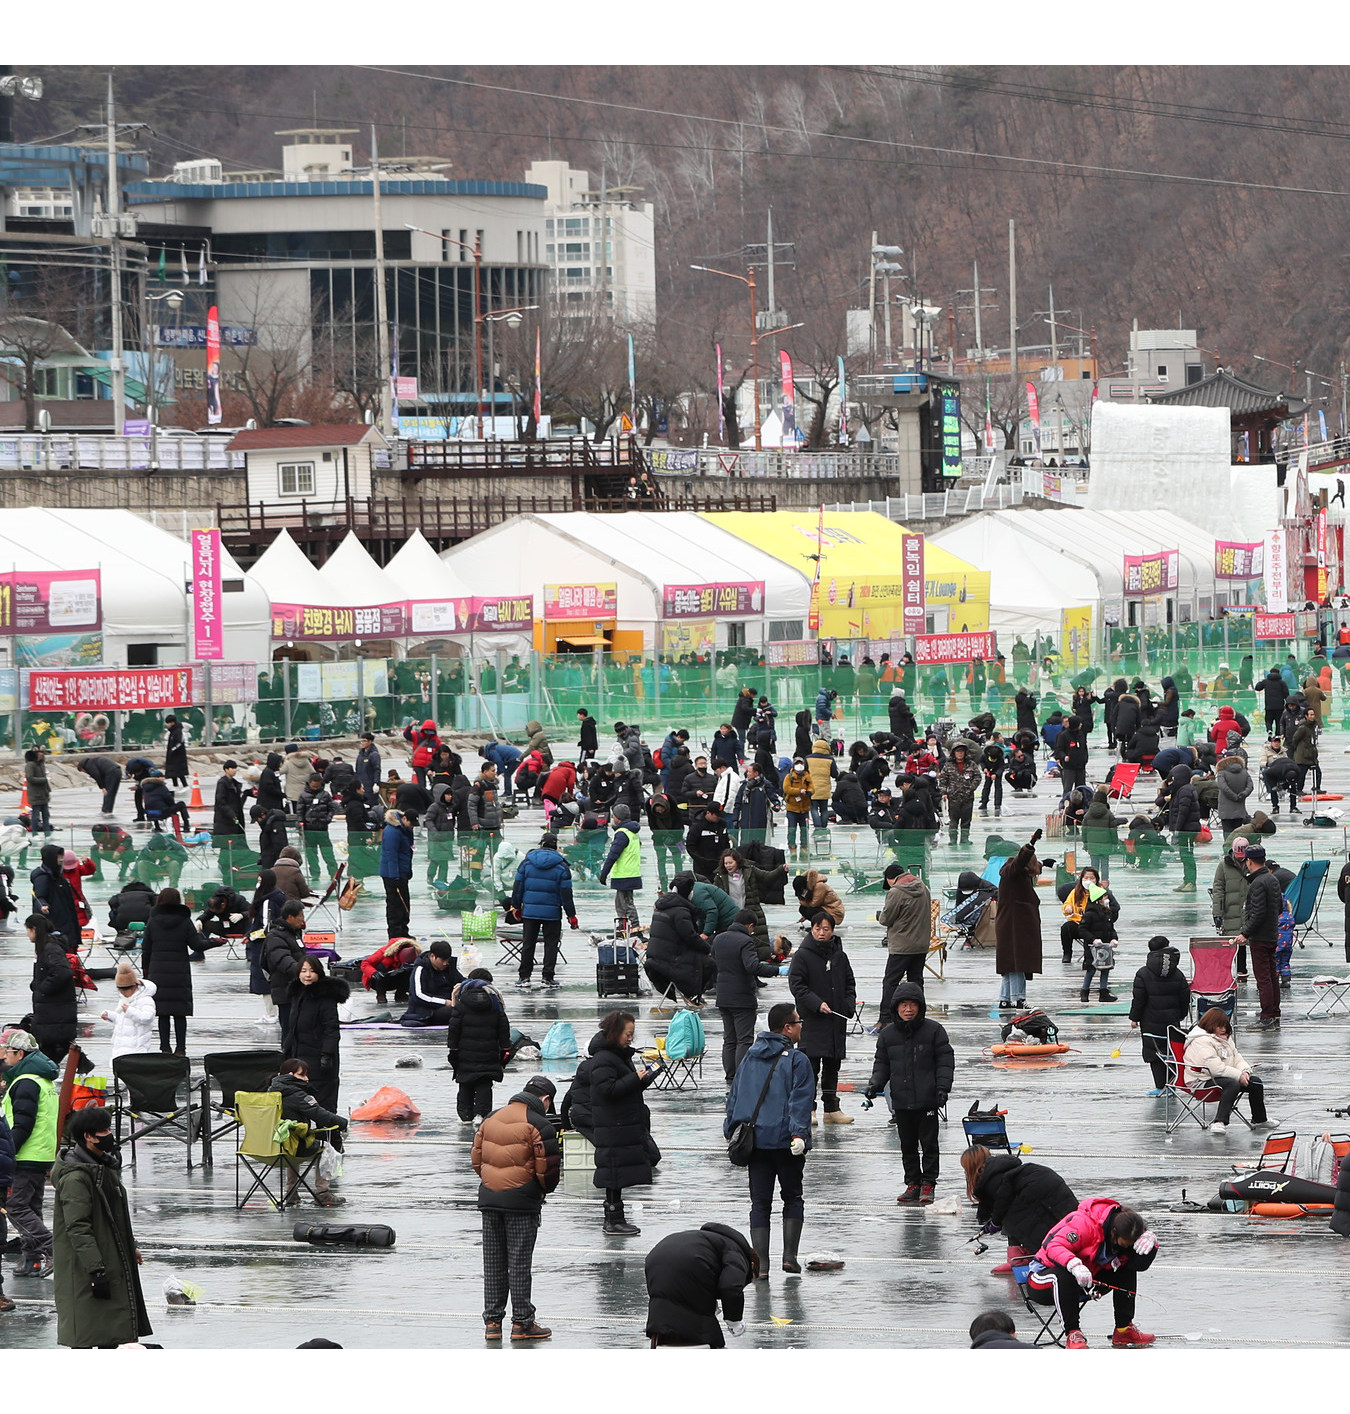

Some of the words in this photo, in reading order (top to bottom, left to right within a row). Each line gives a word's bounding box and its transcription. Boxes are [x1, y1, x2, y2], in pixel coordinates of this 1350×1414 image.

[197, 534, 214, 578] 얼음낚시
[905, 539, 921, 576] 몸녹임
[1271, 544, 1282, 599] 향토주전부리
[198, 580, 215, 623] 현장접수
[675, 589, 700, 613] 몸녹이는
[701, 588, 714, 612] 쉼터
[719, 587, 737, 611] 수유실
[906, 579, 920, 604] 쉼터
[303, 608, 333, 635] 친환경
[333, 609, 353, 635] 낚시
[355, 608, 381, 634] 용품점
[498, 600, 511, 622] 낚시
[512, 599, 531, 622] 가이드
[204, 625, 211, 638] 1
[35, 677, 63, 706] 산천어는
[64, 676, 77, 705] 1인
[78, 675, 117, 704] 3마리까지만
[118, 675, 138, 704] 잡으실
[138, 675, 146, 704] 수
[147, 674, 175, 704] 있습니다!
